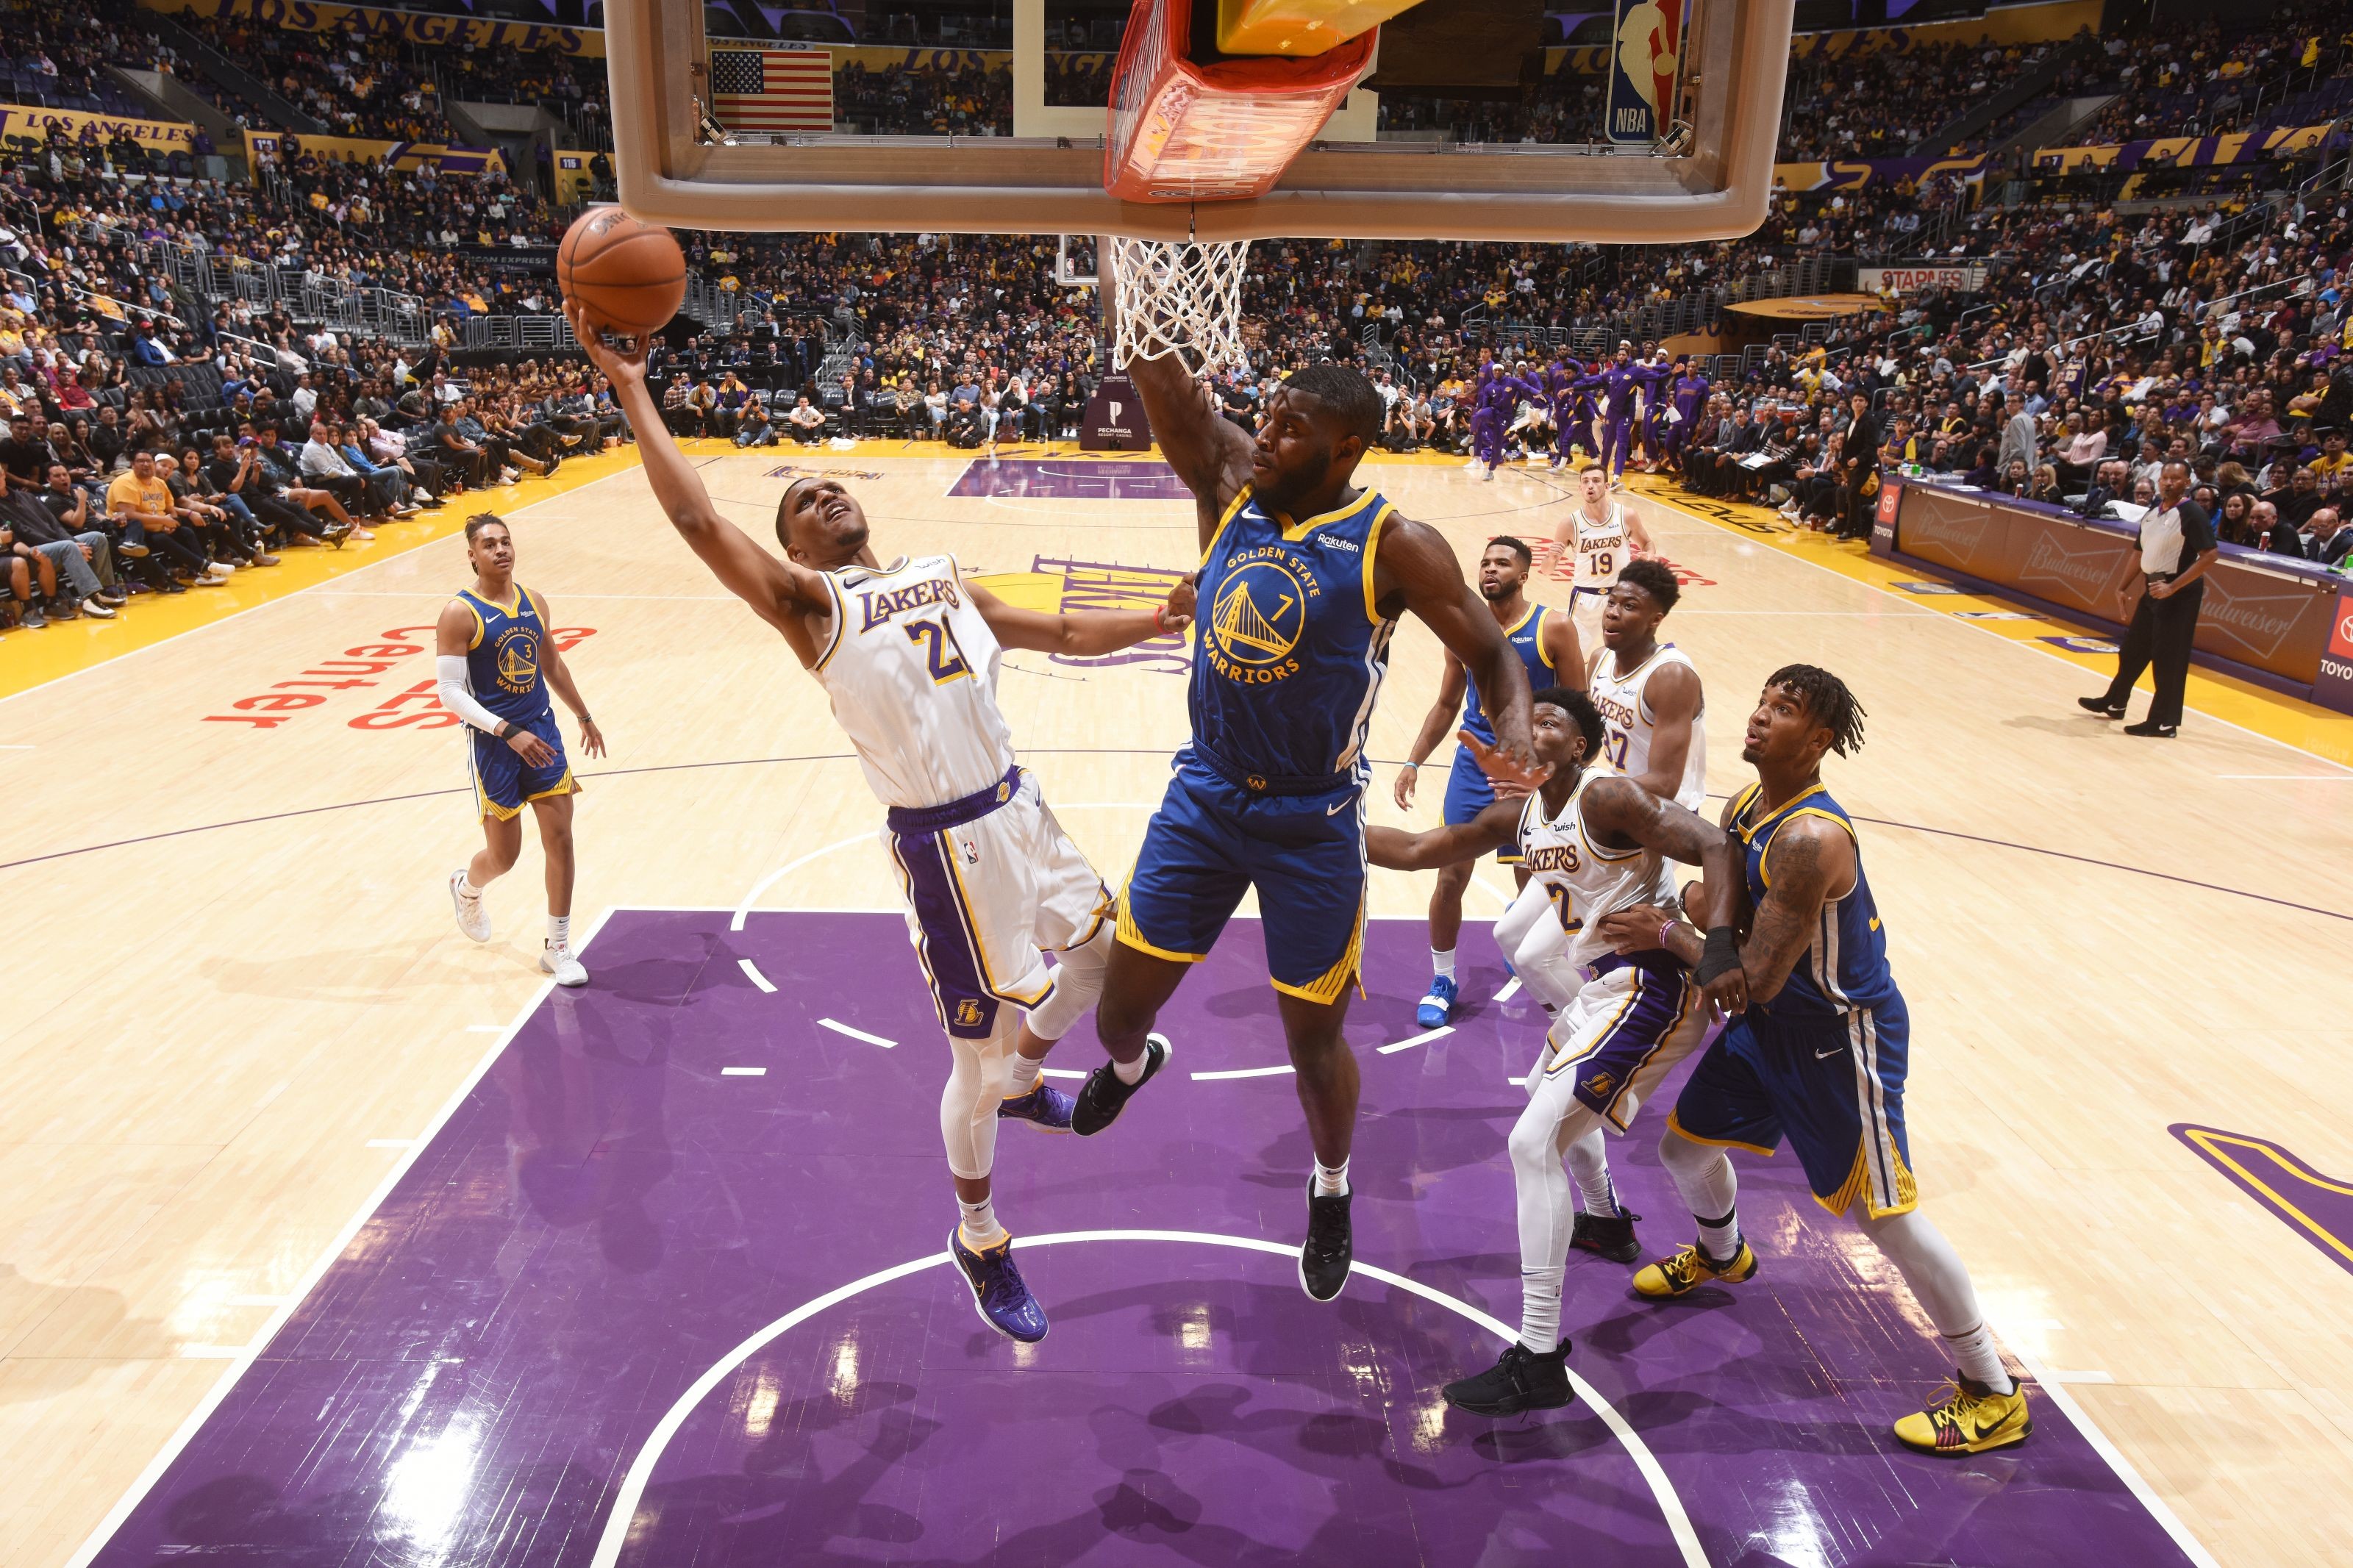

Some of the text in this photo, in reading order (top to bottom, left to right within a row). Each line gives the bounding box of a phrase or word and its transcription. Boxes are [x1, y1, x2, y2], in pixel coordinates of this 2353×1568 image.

[26, 113, 194, 143] LOS ANGELES
[1615, 108, 1646, 132] NBA
[563, 158, 576, 169] 115
[501, 257, 548, 265] EXPRESS
[1874, 525, 1893, 540] TOYOTA
[1916, 512, 1980, 547] Budweiser
[1317, 532, 1360, 553] Rakuten
[1579, 535, 1622, 554] LAKERS
[914, 558, 946, 570] wish
[1227, 546, 1321, 598] GOLDEN STATE
[1589, 552, 1614, 577] 19
[2032, 541, 2110, 584] Budweiser
[856, 578, 960, 637] LAKERS
[1271, 593, 1294, 622] 7
[2200, 587, 2290, 636] udweiser
[494, 626, 518, 648] GOLDEN
[521, 626, 540, 641] STATE
[1511, 636, 1533, 644] Rakuten
[524, 644, 532, 659] 3
[1202, 627, 1300, 684] WARRIORS
[2321, 659, 2353, 681] TOYO
[496, 676, 535, 695] WARRIO
[1553, 821, 1577, 832] wish
